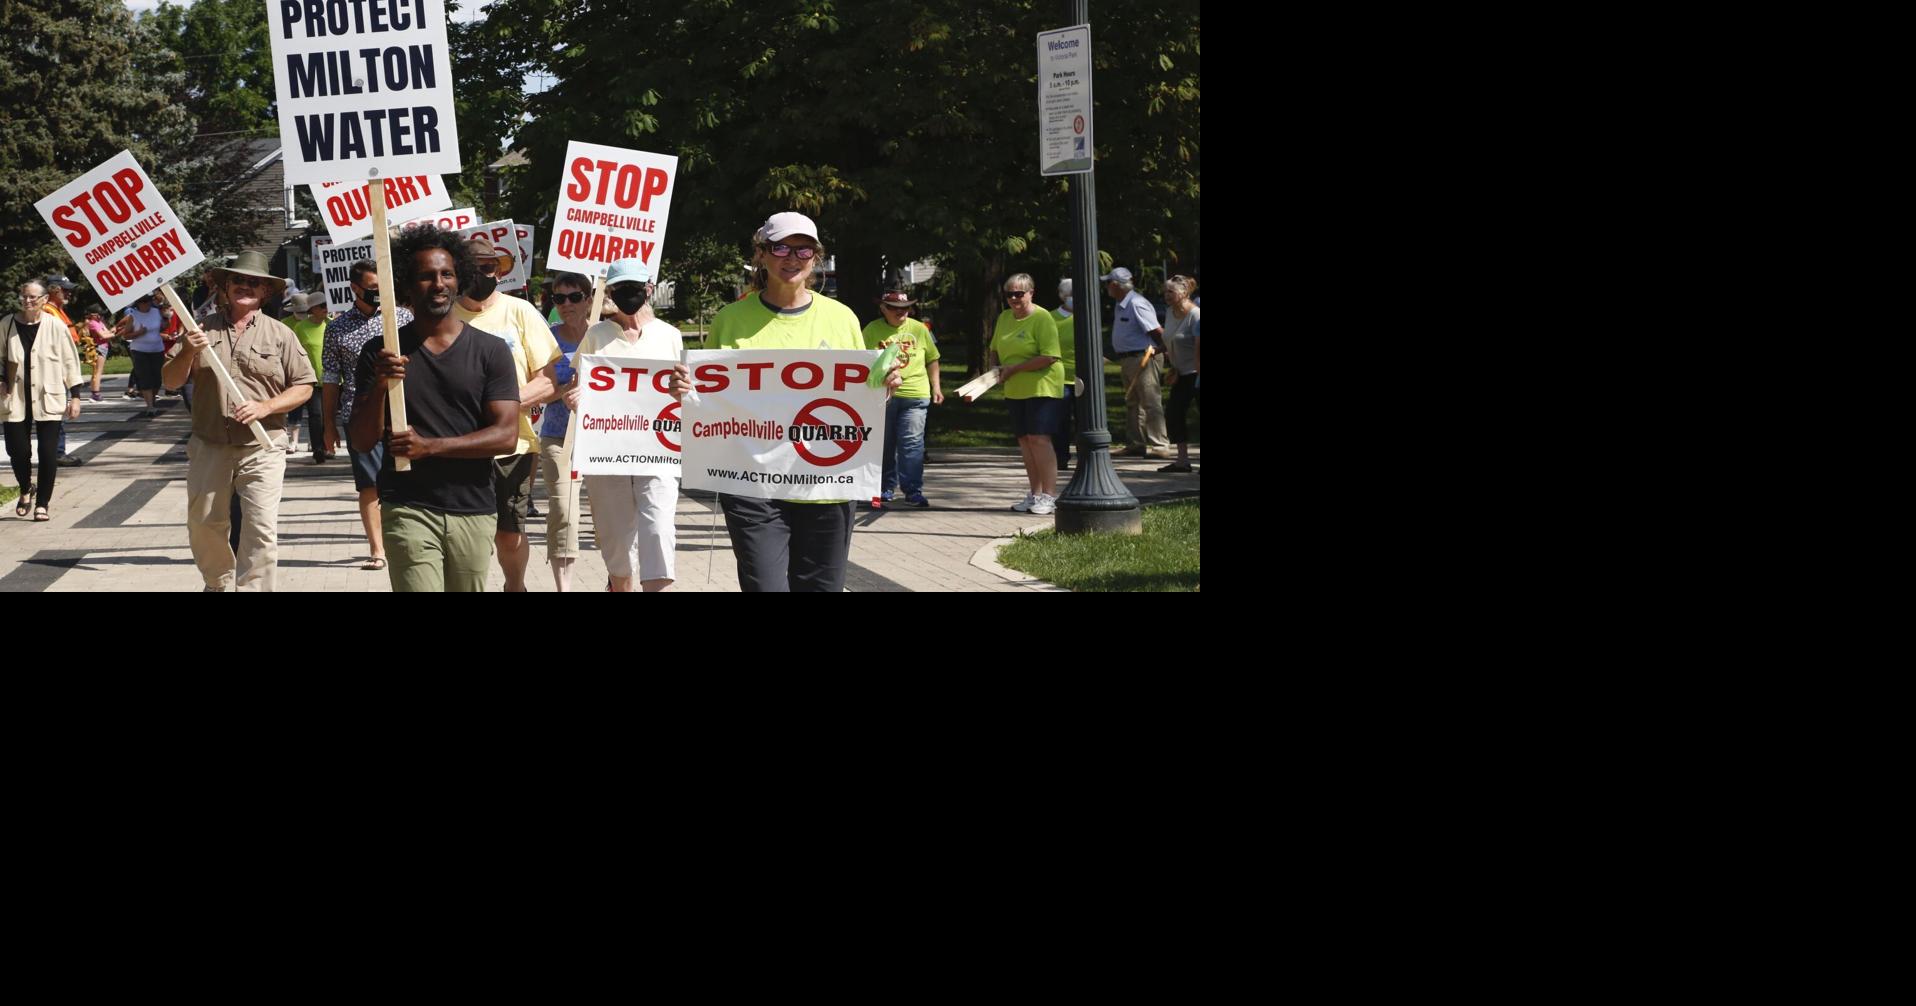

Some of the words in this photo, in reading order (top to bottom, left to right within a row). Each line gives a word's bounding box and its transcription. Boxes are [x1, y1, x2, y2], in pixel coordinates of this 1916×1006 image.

[280, 0, 426, 39] PROTECT
[1048, 39, 1079, 51] Welcome
[287, 44, 436, 99] MILTON
[294, 106, 441, 162] WATER
[567, 157, 668, 212] STOP
[52, 168, 146, 248] STOP
[567, 208, 656, 233] CAMPBELLVILLE
[85, 211, 166, 265] CAMPBELLVILLE
[557, 229, 655, 265] QUARRY
[96, 228, 187, 296] QUARRY
[323, 245, 372, 264] PROTECT
[325, 266, 350, 283] MIL
[588, 366, 674, 394] STO
[694, 361, 871, 394] STOP
[582, 414, 649, 433] Campbellville
[652, 419, 681, 432] QUA
[692, 417, 784, 440] Campbellville
[788, 424, 872, 442] QUARRY
[589, 454, 681, 465] www.ACTIONMilto
[707, 468, 854, 485] www.ACTIONMilton.ca
